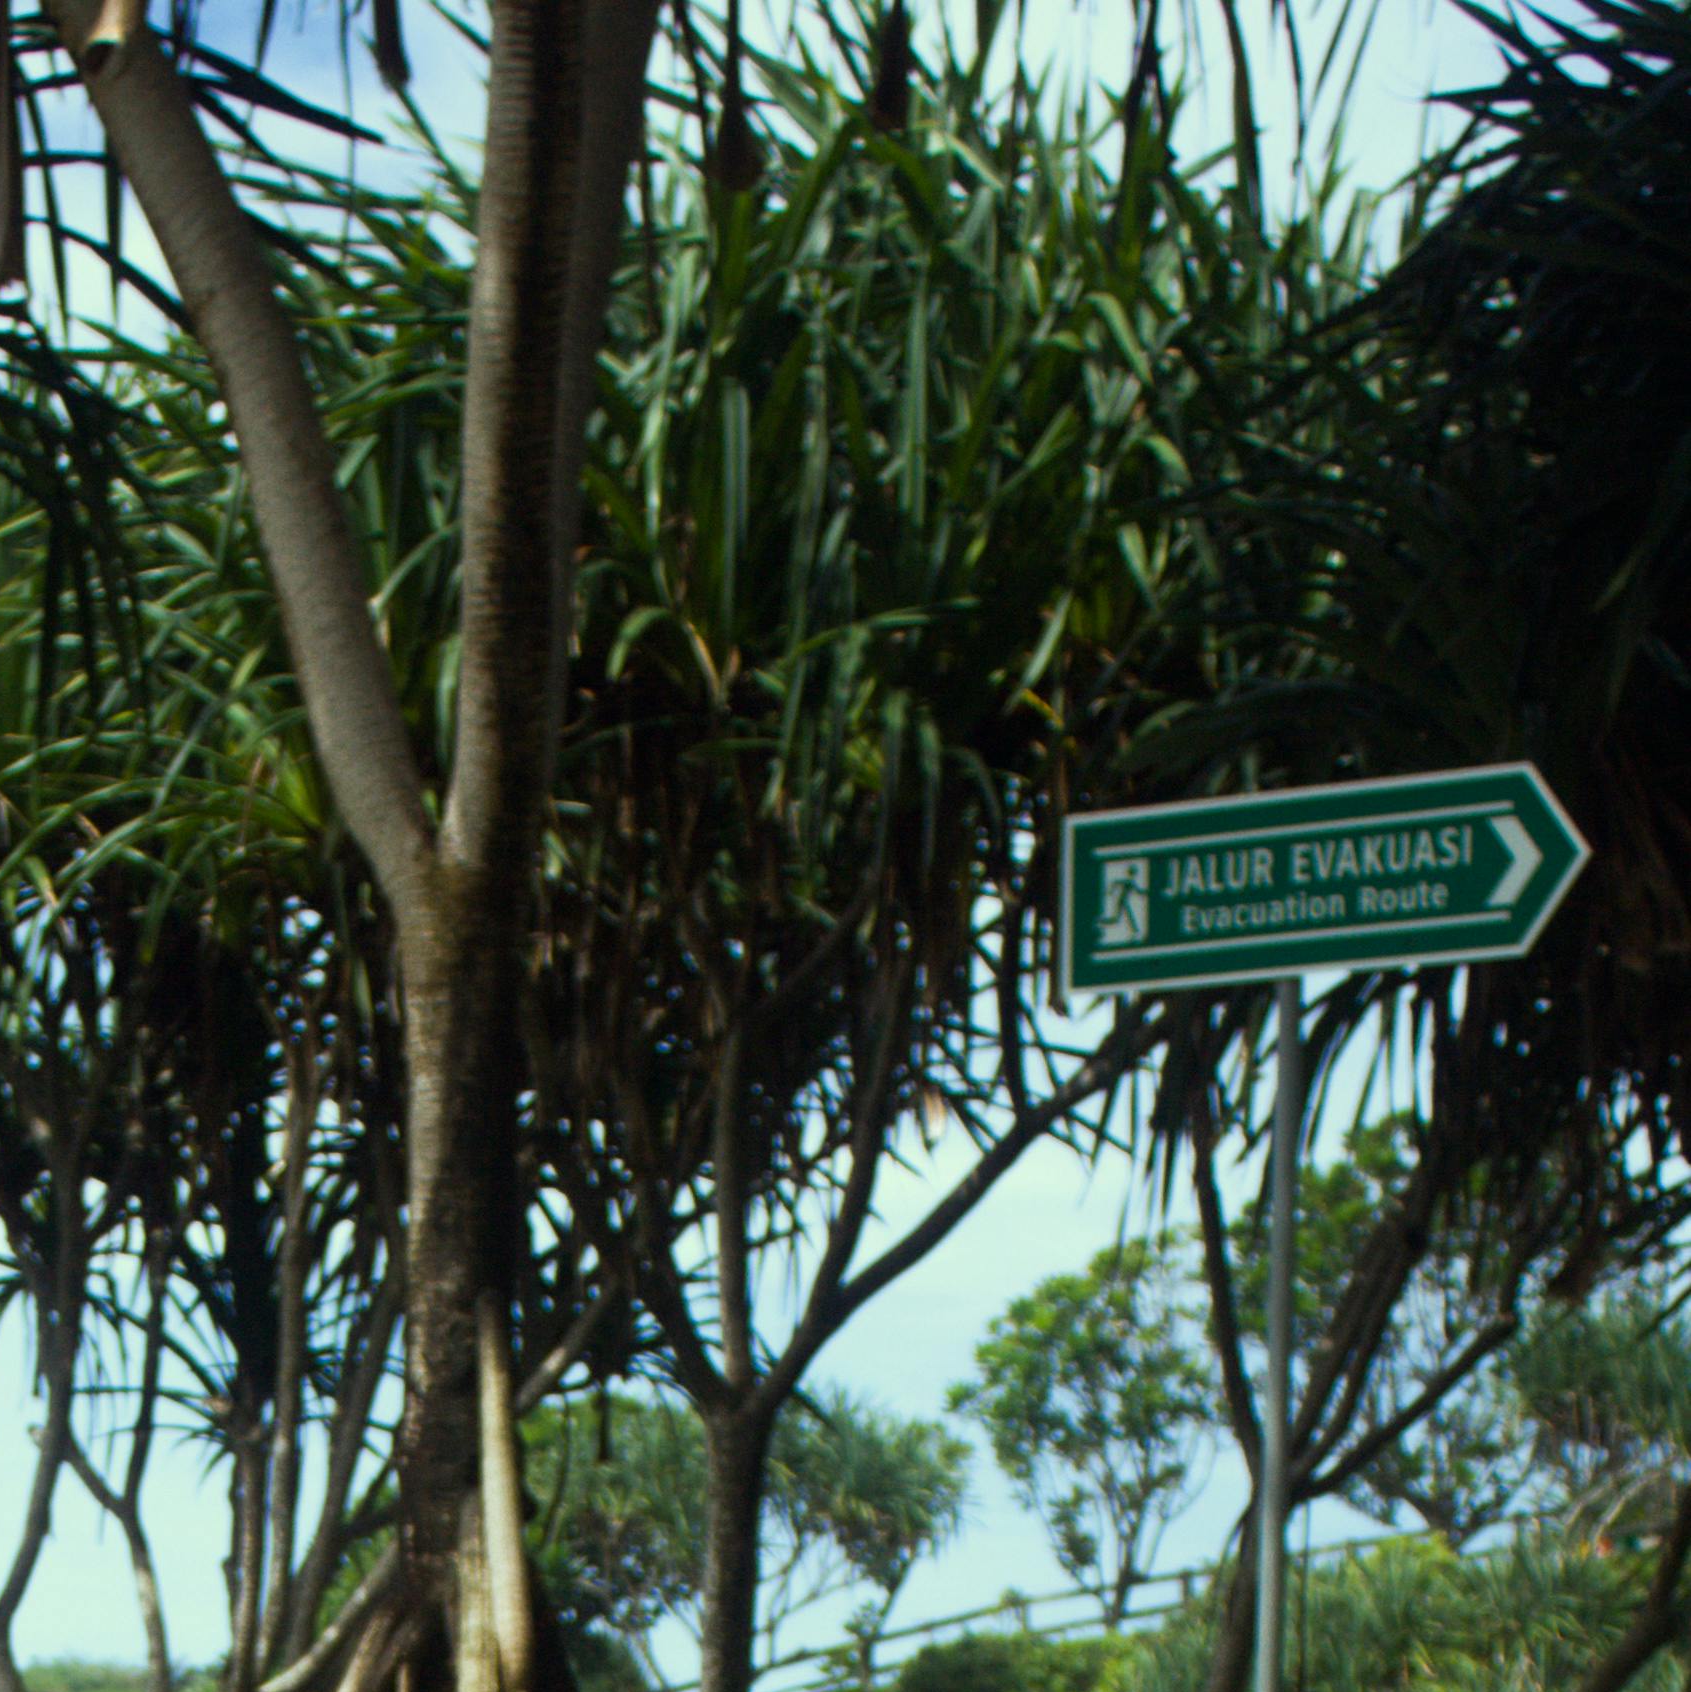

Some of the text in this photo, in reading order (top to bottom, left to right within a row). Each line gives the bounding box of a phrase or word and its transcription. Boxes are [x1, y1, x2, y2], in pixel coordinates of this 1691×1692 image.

[1163, 825, 1473, 898] JALUR EVAKUASI
[1181, 881, 1449, 934] Evacuation Route
